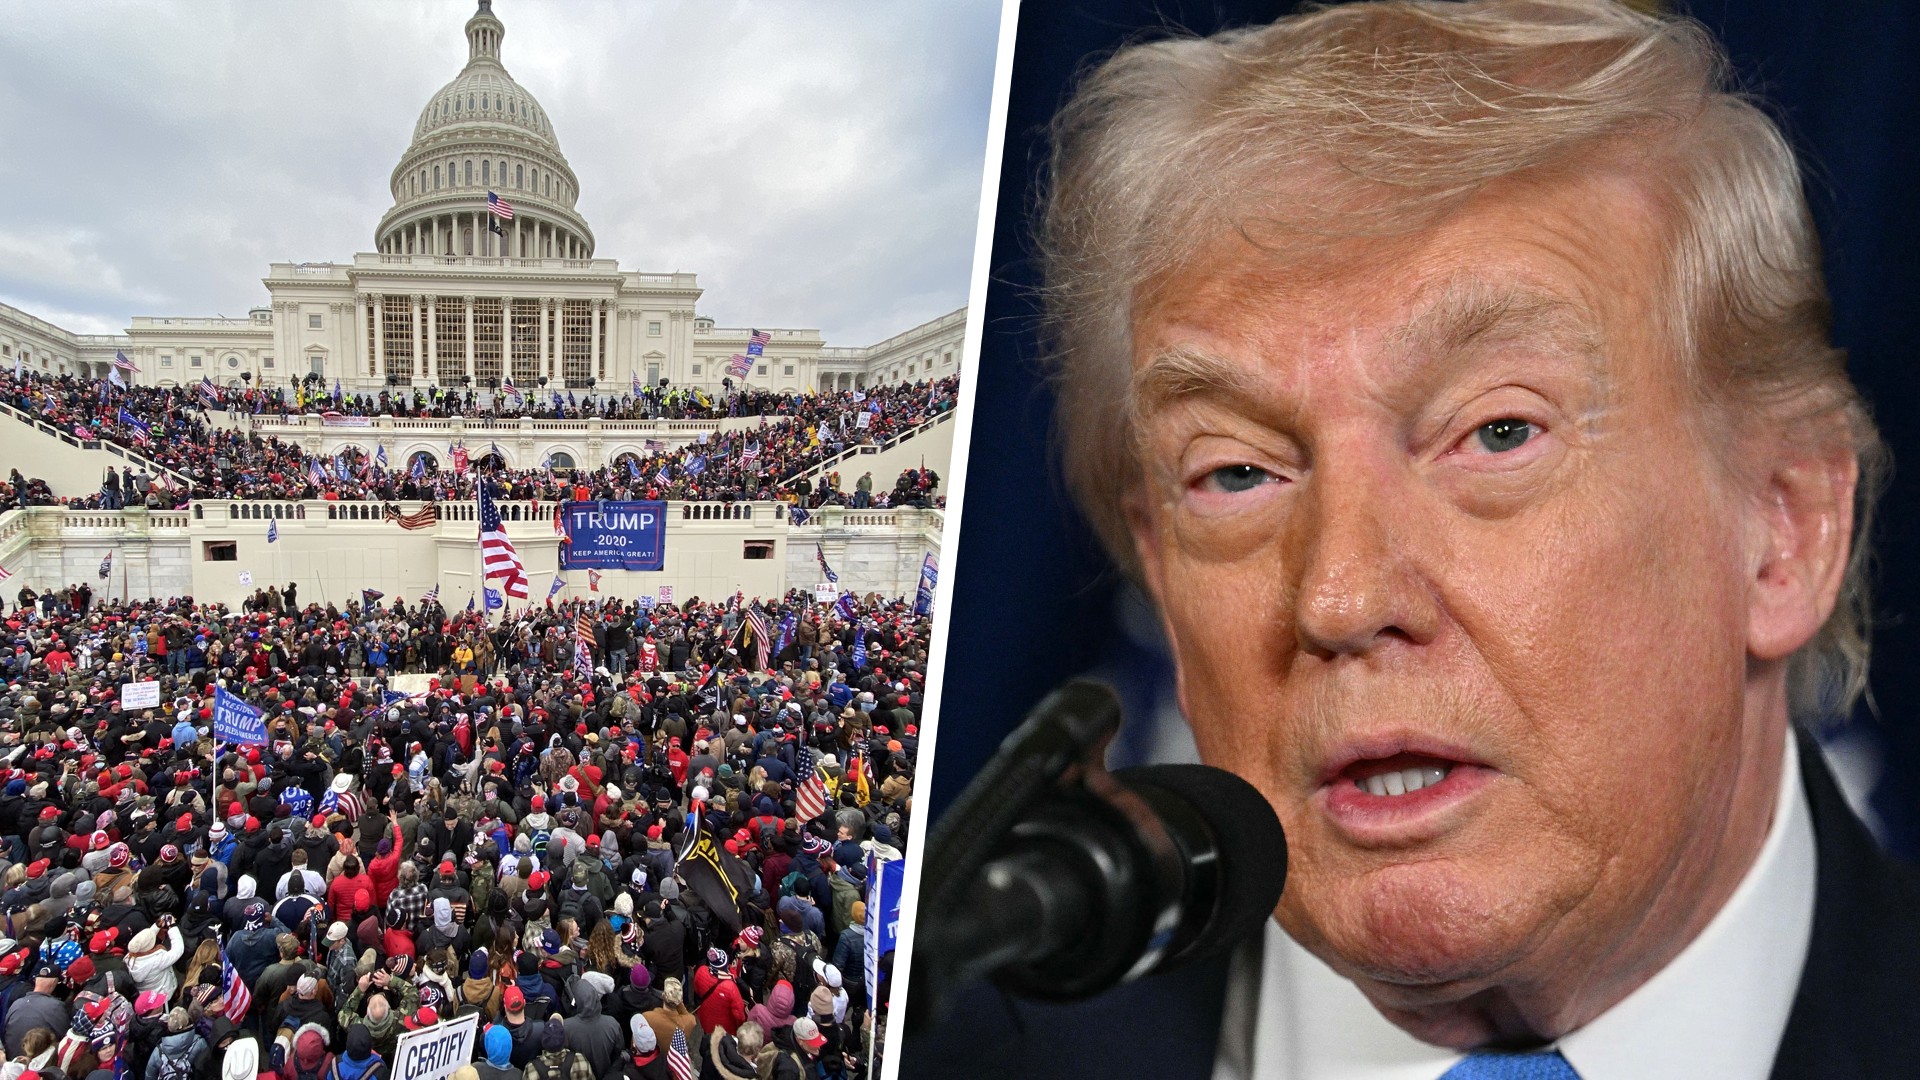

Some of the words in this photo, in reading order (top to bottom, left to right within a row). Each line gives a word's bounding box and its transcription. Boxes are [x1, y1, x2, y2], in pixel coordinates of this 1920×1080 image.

[572, 511, 655, 530] TRUMP
[213, 721, 225, 731] OD
[225, 725, 239, 736] BLESS
[217, 706, 261, 732] TRUMP
[405, 1029, 468, 1080] CERTIFY
